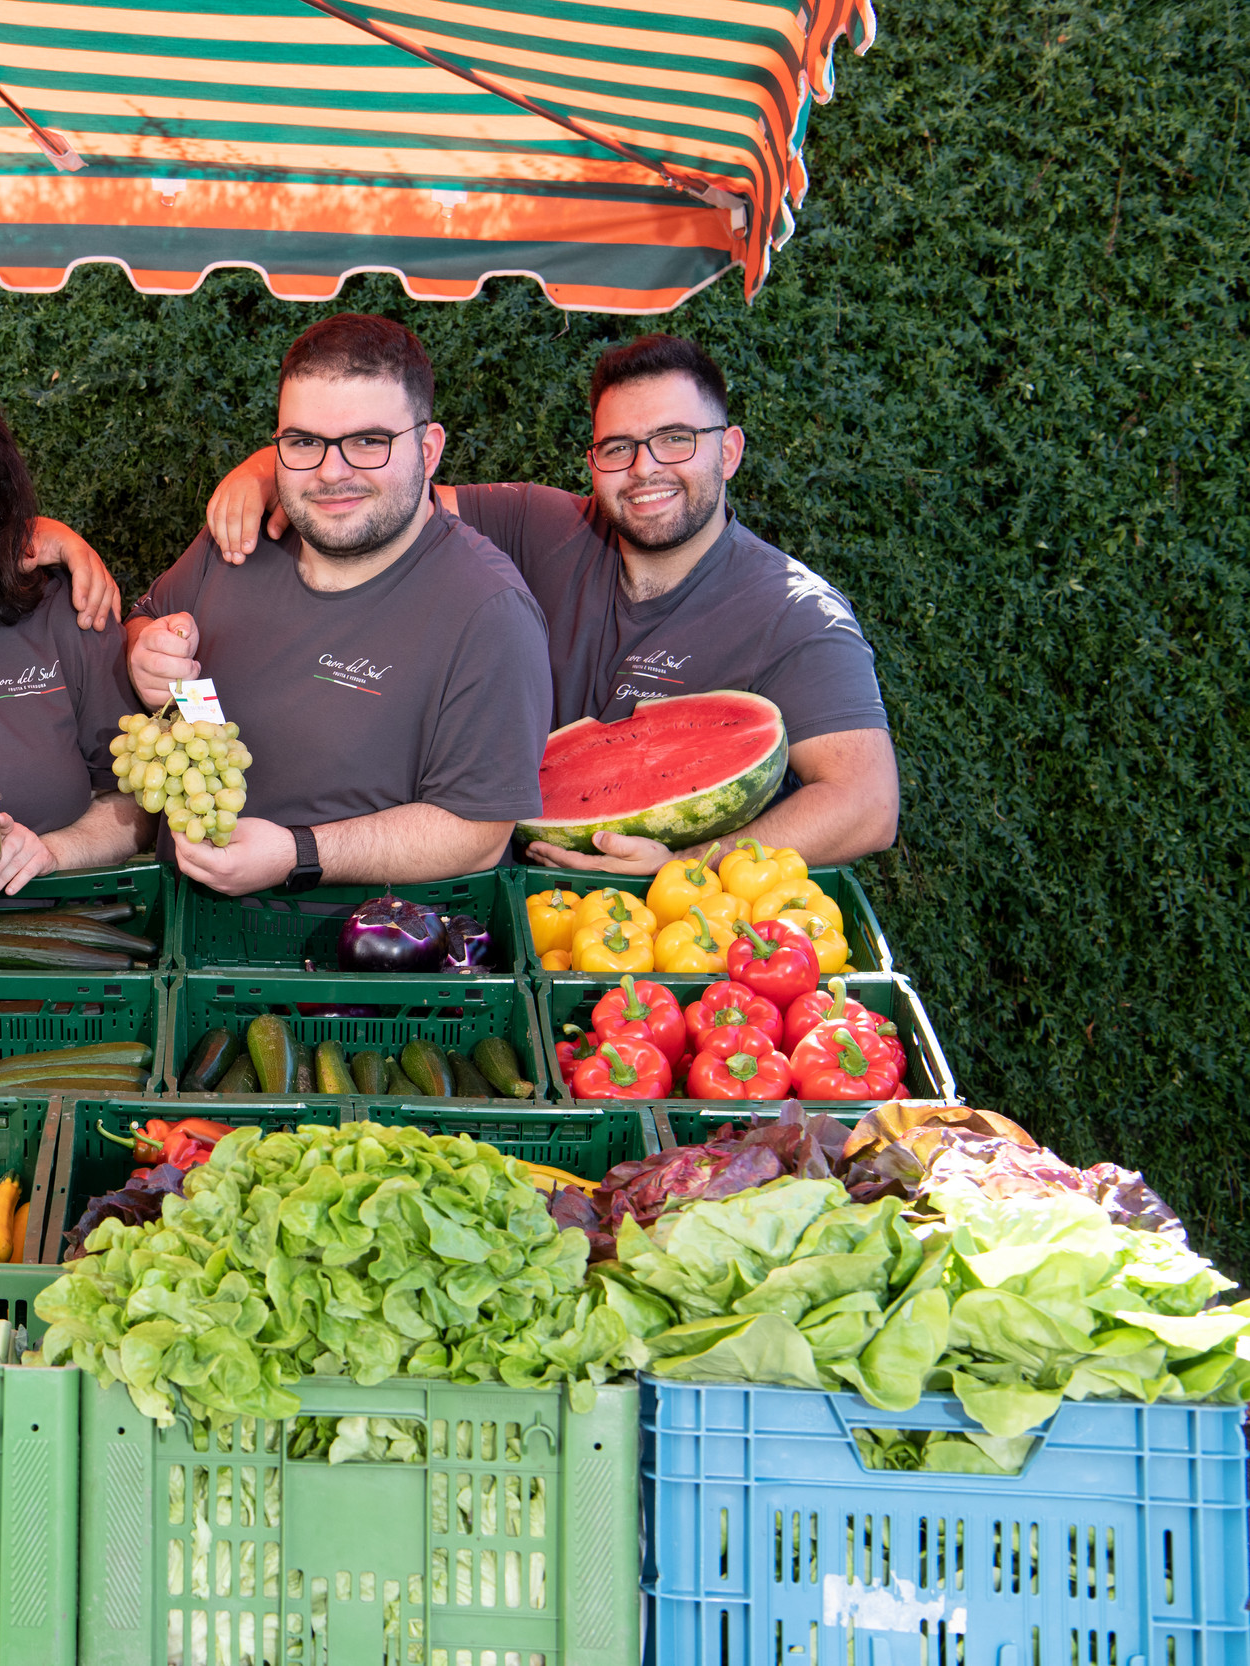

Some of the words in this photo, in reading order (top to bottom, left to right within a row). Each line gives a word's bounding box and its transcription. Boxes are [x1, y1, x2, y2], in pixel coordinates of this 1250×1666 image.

[17, 665, 35, 684] del
[37, 659, 59, 681] Sud
[319, 653, 344, 669] Cuore
[345, 657, 369, 673] del
[362, 665, 392, 680] Sud
[643, 649, 667, 664] del
[661, 655, 691, 670] Sud
